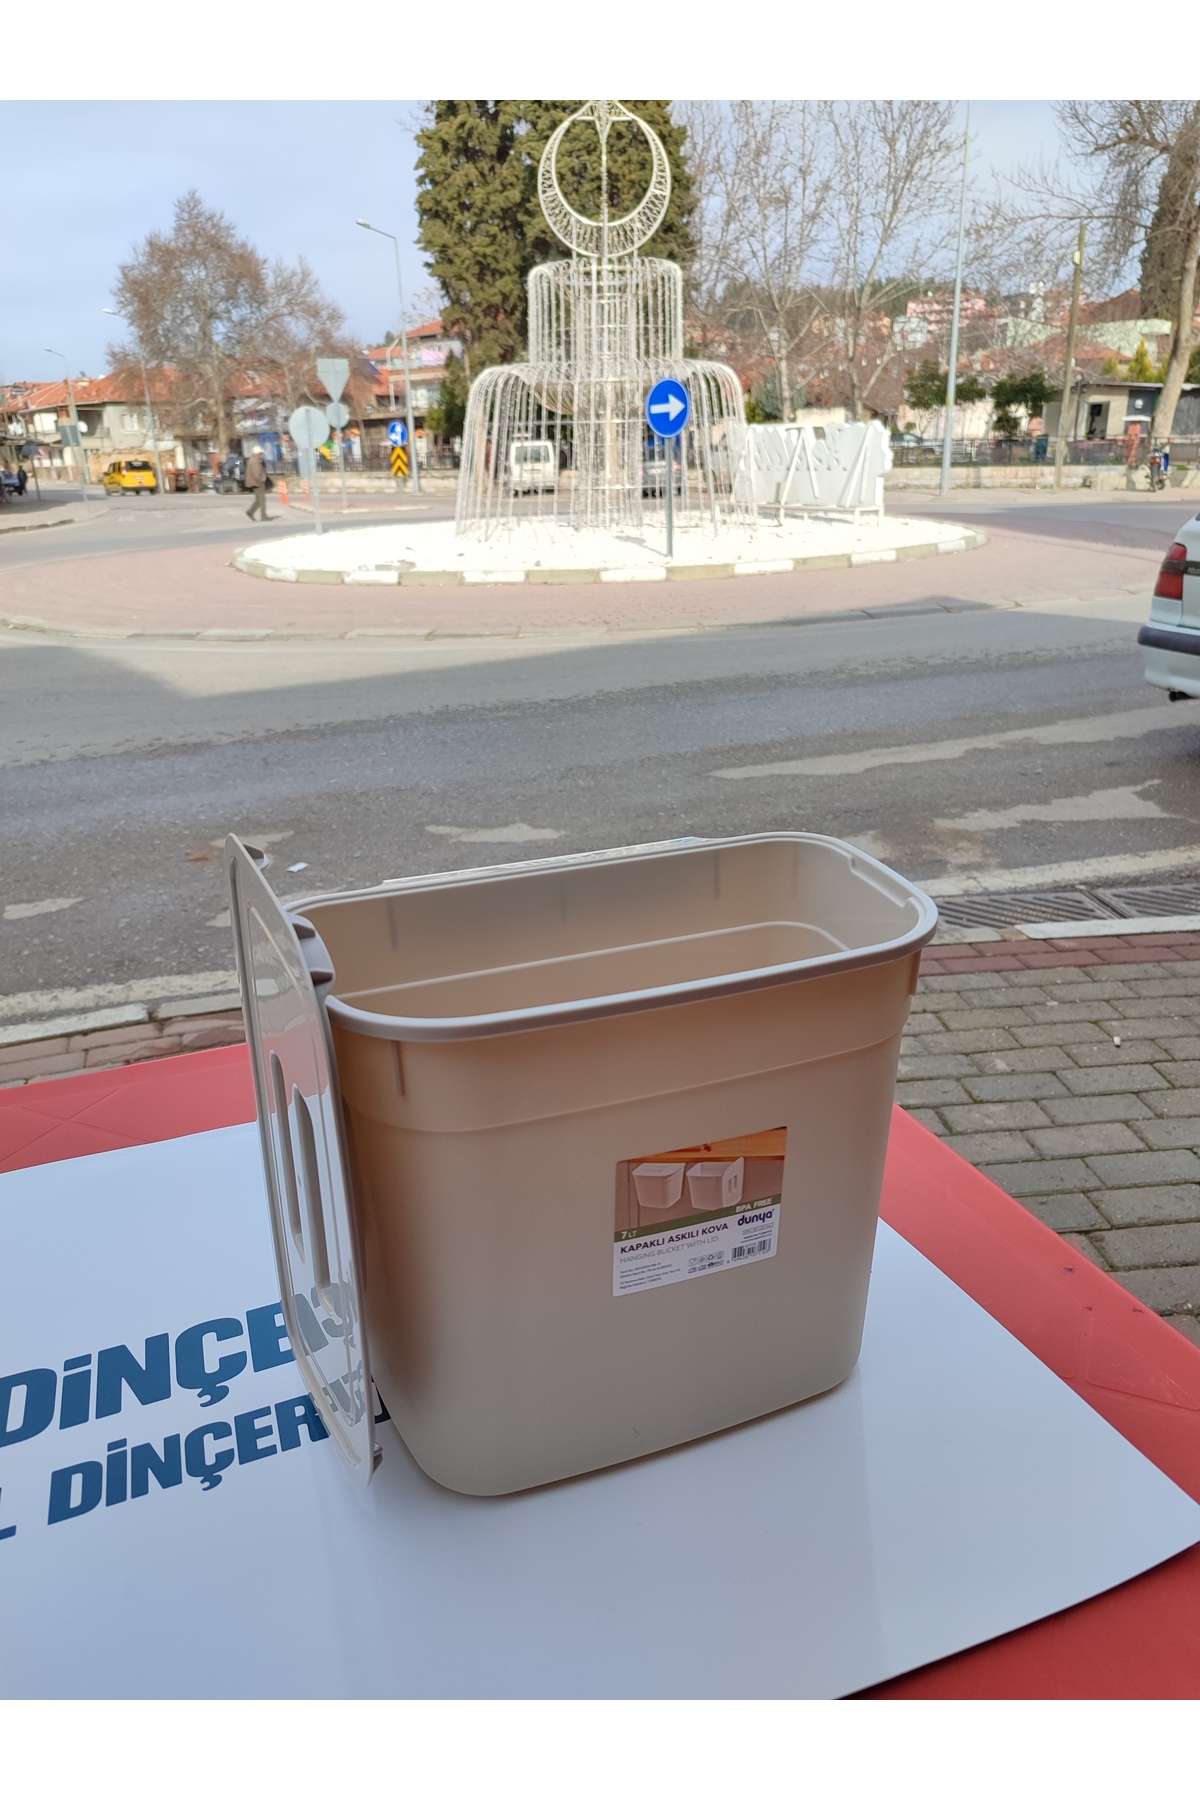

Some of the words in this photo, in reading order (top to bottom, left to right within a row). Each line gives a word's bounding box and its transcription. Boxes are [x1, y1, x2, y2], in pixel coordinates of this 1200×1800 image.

[735, 1204, 752, 1213] BPA
[753, 1198, 772, 1208] FREE
[620, 1237, 665, 1254] KAPAKLI
[667, 1229, 699, 1243] ASKILI
[701, 1223, 728, 1235] KOVA
[620, 1250, 656, 1263] HANGING
[656, 1244, 686, 1256] BUCKET
[686, 1239, 706, 1249] WITH
[706, 1236, 719, 1244] LID
